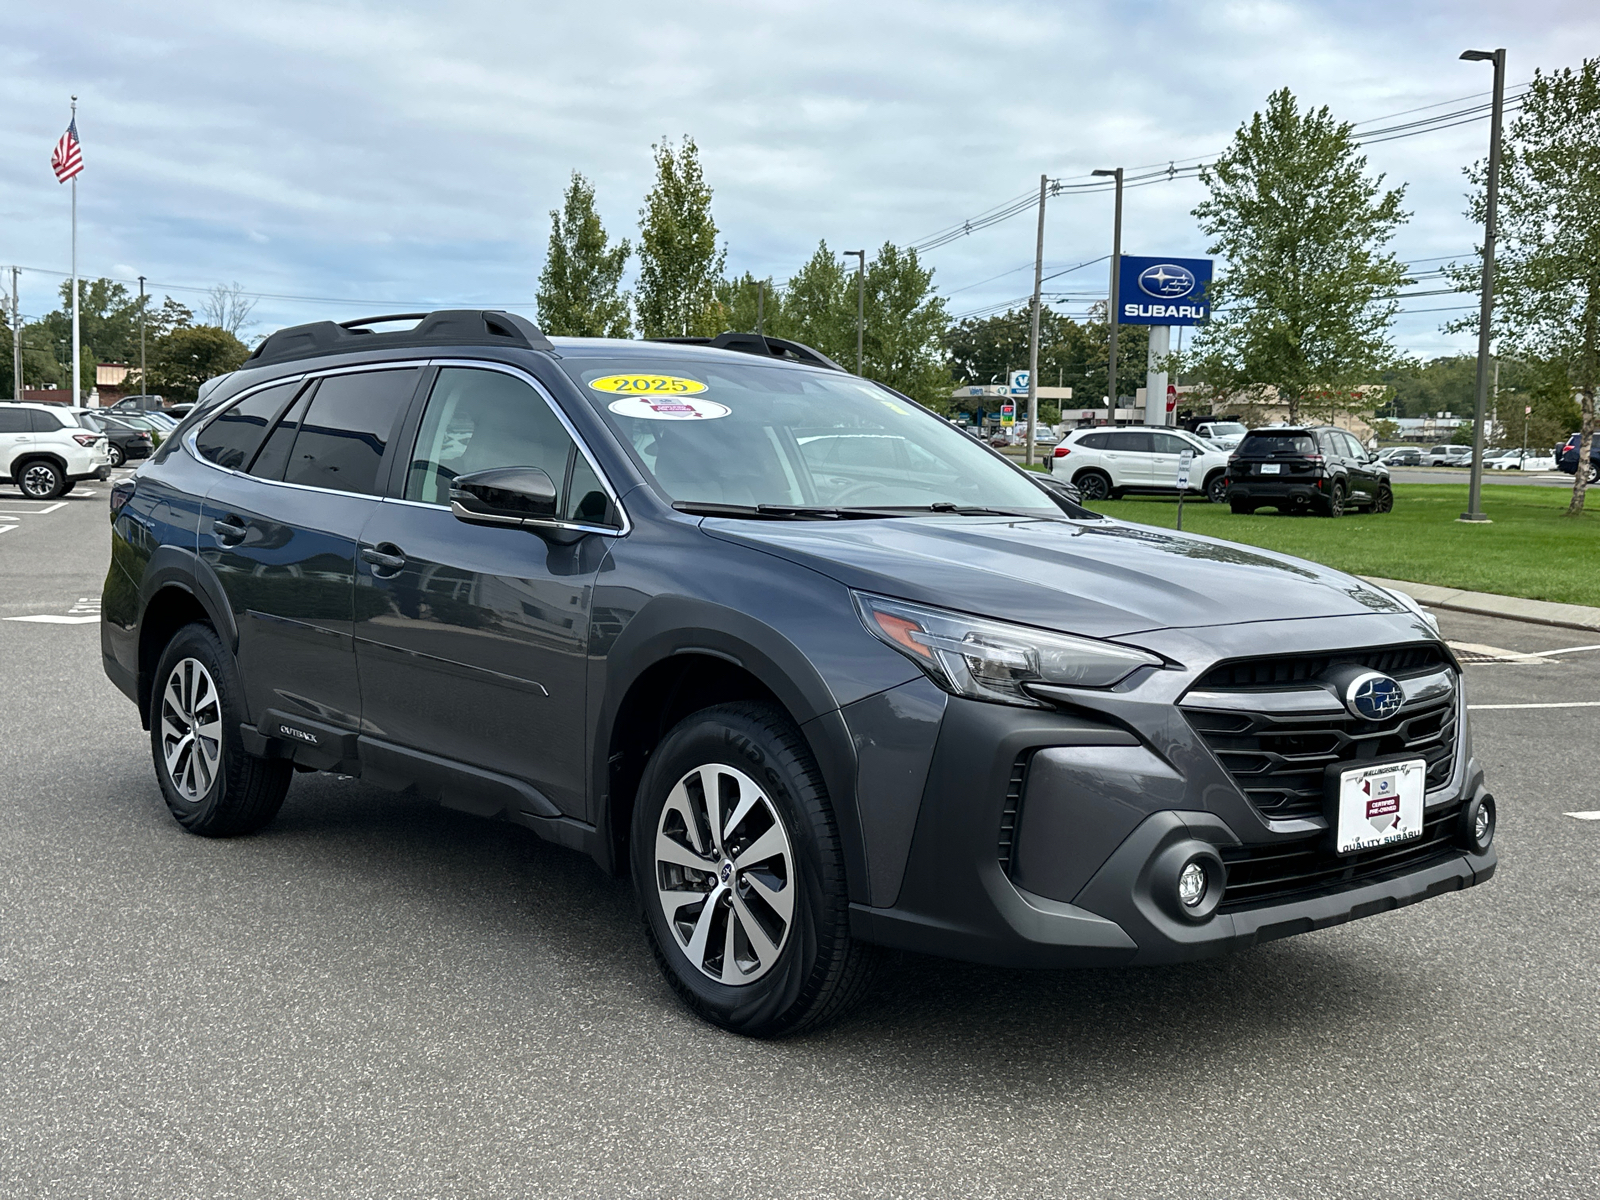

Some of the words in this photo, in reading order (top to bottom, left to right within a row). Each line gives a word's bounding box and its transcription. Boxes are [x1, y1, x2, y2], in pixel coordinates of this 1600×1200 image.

[1124, 303, 1204, 318] SUBARU
[613, 378, 688, 392] 2025
[280, 725, 318, 743] OUTBACK
[1369, 805, 1397, 815] PRE-OWNED
[1371, 799, 1395, 808] CERTIFIED
[1343, 838, 1381, 853] QUALITY
[1384, 829, 1421, 843] SUBARU
